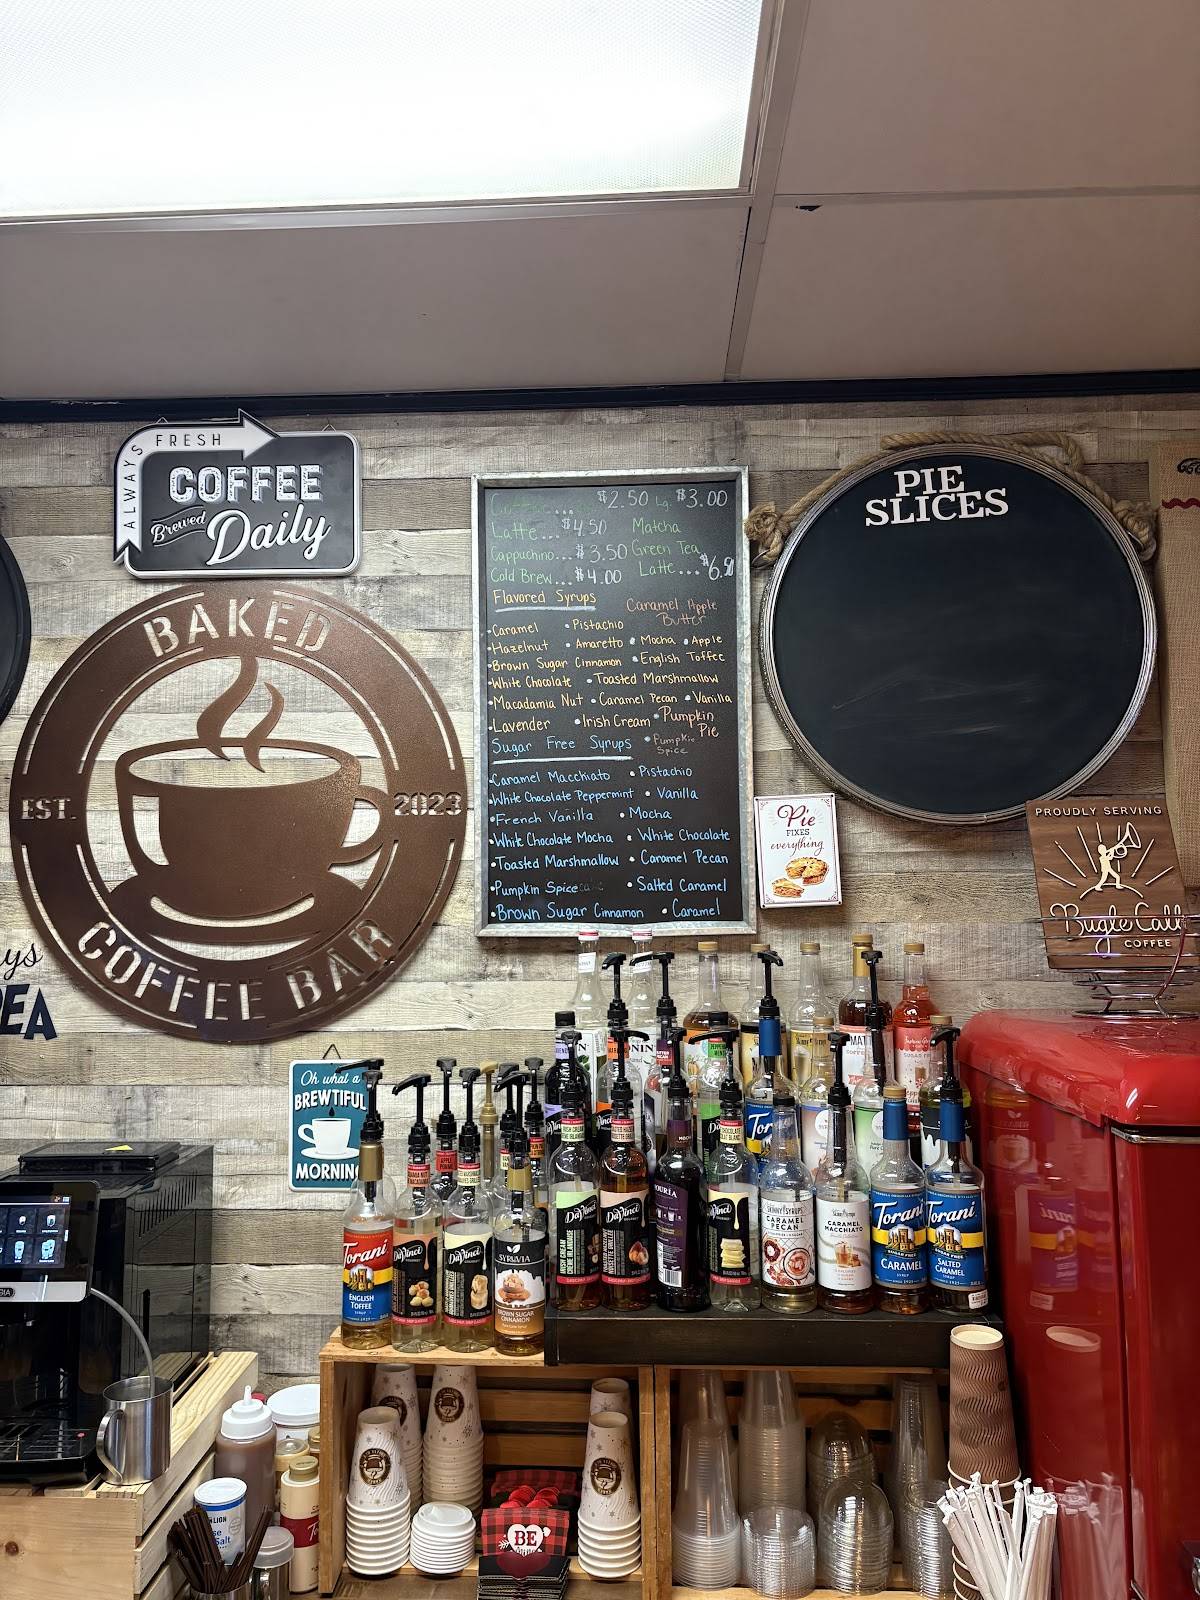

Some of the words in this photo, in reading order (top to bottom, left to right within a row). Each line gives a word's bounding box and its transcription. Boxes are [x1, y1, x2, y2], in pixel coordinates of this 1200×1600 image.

[156, 433, 221, 447] FRESH
[123, 444, 144, 529] ALWAYS
[169, 464, 322, 503] COFFEE
[894, 465, 965, 497] PIE
[597, 489, 649, 509] $2.50
[676, 488, 727, 508] $3.00
[865, 487, 1009, 527] SLICES
[150, 511, 206, 543] Brewed
[206, 503, 332, 566] Daily
[632, 517, 681, 535] Matcha
[631, 538, 671, 556] Green
[676, 540, 701, 554] Tea
[490, 567, 515, 582] Cold
[574, 566, 622, 585] $4.00
[492, 589, 545, 604] Flavored
[555, 589, 597, 607] Syrups
[626, 598, 679, 612] Caramel
[687, 598, 718, 615] Apple
[572, 618, 624, 630] Pistachio
[656, 612, 706, 626] Butter
[143, 598, 334, 658] BAKED
[492, 622, 538, 637] Caramel
[491, 640, 549, 655] Hazelnut
[575, 637, 623, 648] Amaretto
[640, 635, 676, 646] Mocha
[691, 635, 723, 647] Apple
[491, 660, 529, 672] Brown
[536, 657, 568, 672] Sugar
[575, 657, 622, 668] Cinnamon
[640, 651, 681, 667] English
[686, 651, 725, 661] Toffee
[491, 676, 522, 689] White
[525, 676, 572, 688] Chocolate
[593, 672, 637, 685] Toasted
[643, 672, 719, 684] Marshmallow
[493, 695, 556, 710] Macadamia
[561, 693, 584, 707] Nut
[599, 691, 645, 706] Caramel
[649, 692, 678, 703] Pecan
[692, 690, 733, 704] Vanilla
[492, 716, 551, 733] Lavender
[582, 713, 611, 728] Irish
[613, 713, 651, 728] Cream
[658, 705, 714, 728] Pumpkin
[697, 722, 720, 738] Pie
[492, 738, 532, 757] Sugar
[546, 736, 576, 750] Free
[590, 735, 632, 753] Syrups
[657, 746, 688, 757] Spice
[492, 772, 541, 787] Caramel
[548, 769, 611, 784] Macchiato
[639, 765, 693, 777] Pistachio
[492, 791, 522, 806] White
[524, 790, 572, 803] Chocolate
[574, 788, 634, 804] Peppermint
[657, 787, 698, 799] Vanilla
[20, 797, 78, 822] EST.
[393, 792, 463, 817] 2023
[628, 806, 672, 819] Mocha
[1035, 807, 1097, 817] PROUDLY
[1104, 806, 1162, 816] SERVING
[495, 811, 542, 827] French
[548, 807, 594, 823] Vanilla
[777, 804, 816, 827] Pie
[493, 831, 525, 848] White
[527, 831, 572, 847] Chocolate
[577, 831, 614, 843] Mocha
[637, 827, 674, 841] White
[678, 828, 731, 841] Chocolate
[786, 828, 810, 836] FIXES
[770, 837, 825, 857] everything
[495, 855, 540, 871] Toasted
[545, 853, 620, 868] Marshmallow
[640, 849, 687, 865] Caramel
[692, 849, 729, 864] Pecan
[495, 880, 540, 901] Pumpkin
[545, 881, 579, 896] Spice
[637, 876, 673, 892] Salted
[680, 878, 727, 892] Caramel
[496, 903, 540, 921] Brown
[546, 901, 587, 920] Sugar
[594, 902, 644, 918] Cinnamon
[672, 897, 721, 918] Caramel
[1050, 903, 1133, 955] Bugle
[1135, 902, 1182, 932] Call
[1124, 939, 1173, 948] COFFEE
[77, 920, 265, 1021] COFFEE
[286, 918, 394, 1010] BAR
[0, 984, 58, 1040] EA
[300, 1070, 319, 1086] Oh
[323, 1072, 349, 1084] what
[352, 1074, 360, 1083] a
[294, 1089, 367, 1111] BREWTIFUL
[564, 1202, 597, 1223] DaVinci
[605, 1203, 640, 1224] DaVinci
[766, 1216, 804, 1224] CARAMEL
[873, 1198, 924, 1230] Torani
[926, 1201, 975, 1228] Torani
[824, 1225, 864, 1233] MACCHIATO
[344, 1239, 388, 1268] Torani
[393, 1244, 424, 1263] DaVinci
[448, 1245, 482, 1265] DaVinci
[498, 1253, 531, 1263] SYRUVIA
[880, 1258, 923, 1271] CARAMEL
[935, 1265, 965, 1277] CARAMEL
[938, 1258, 961, 1268] SALTED
[351, 1301, 372, 1309] TOFFEE
[497, 1309, 515, 1318] BROWN
[515, 1310, 534, 1318] SUGAR
[215, 1536, 231, 1545] Salt
[514, 1531, 537, 1546] BE
